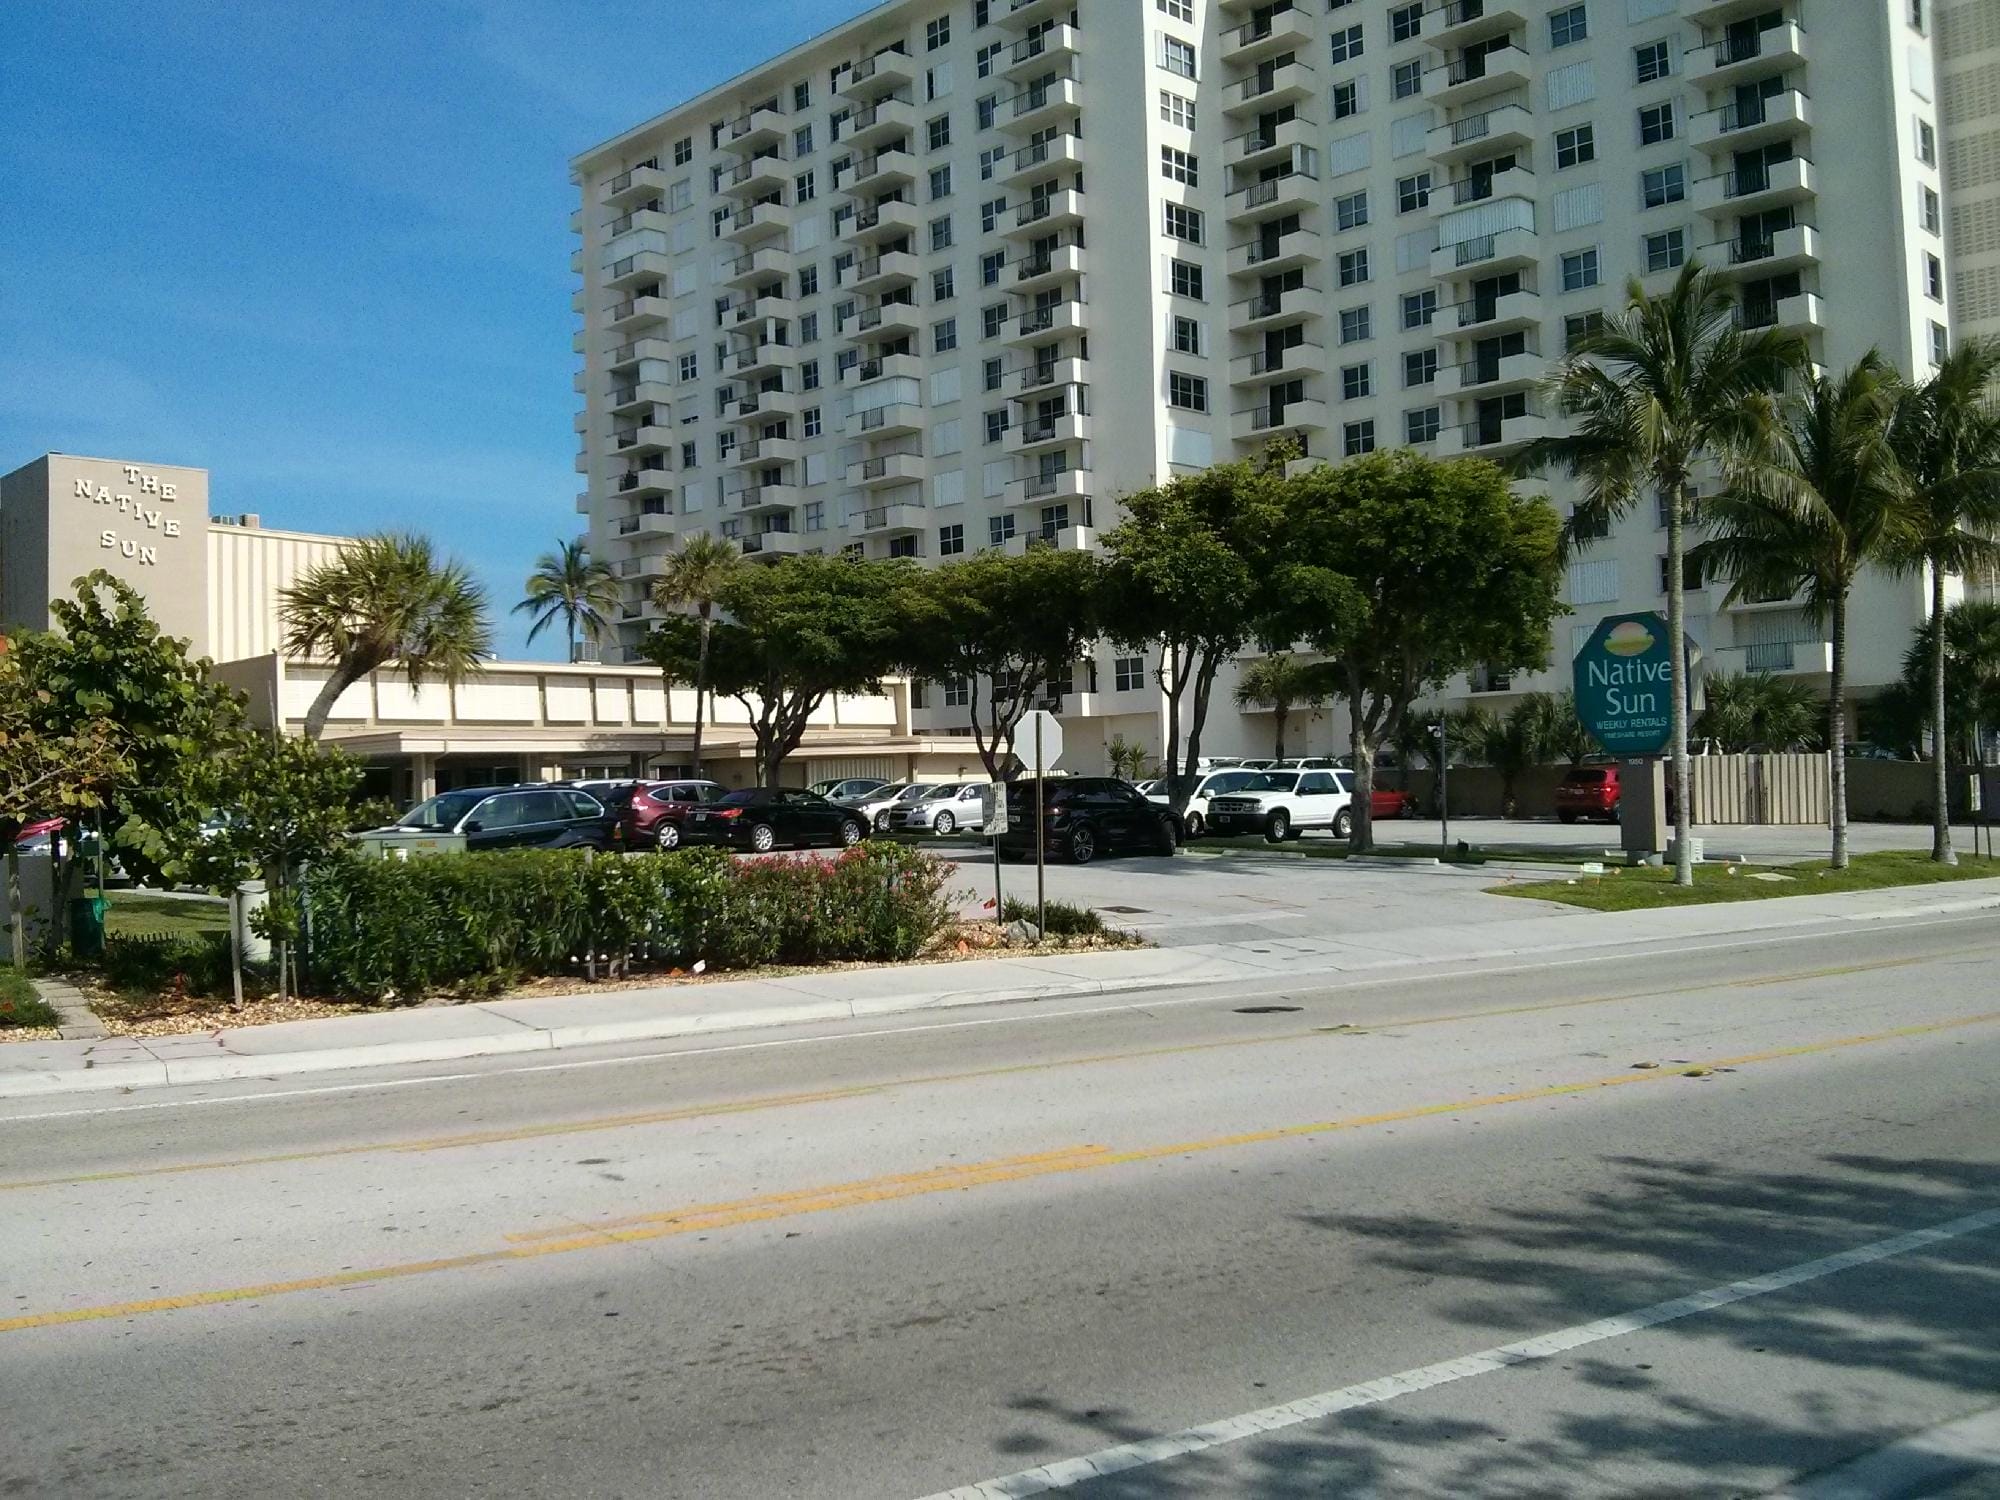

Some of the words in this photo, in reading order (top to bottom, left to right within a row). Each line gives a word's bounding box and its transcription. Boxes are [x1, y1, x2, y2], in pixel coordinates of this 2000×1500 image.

[123, 465, 176, 502] THE
[74, 479, 181, 537] NATIVE
[101, 530, 157, 565] SUN
[1588, 659, 1672, 687] Native
[1605, 688, 1656, 715] Sun
[1596, 719, 1628, 729] WEEKLY
[1630, 717, 1668, 728] RENTALS
